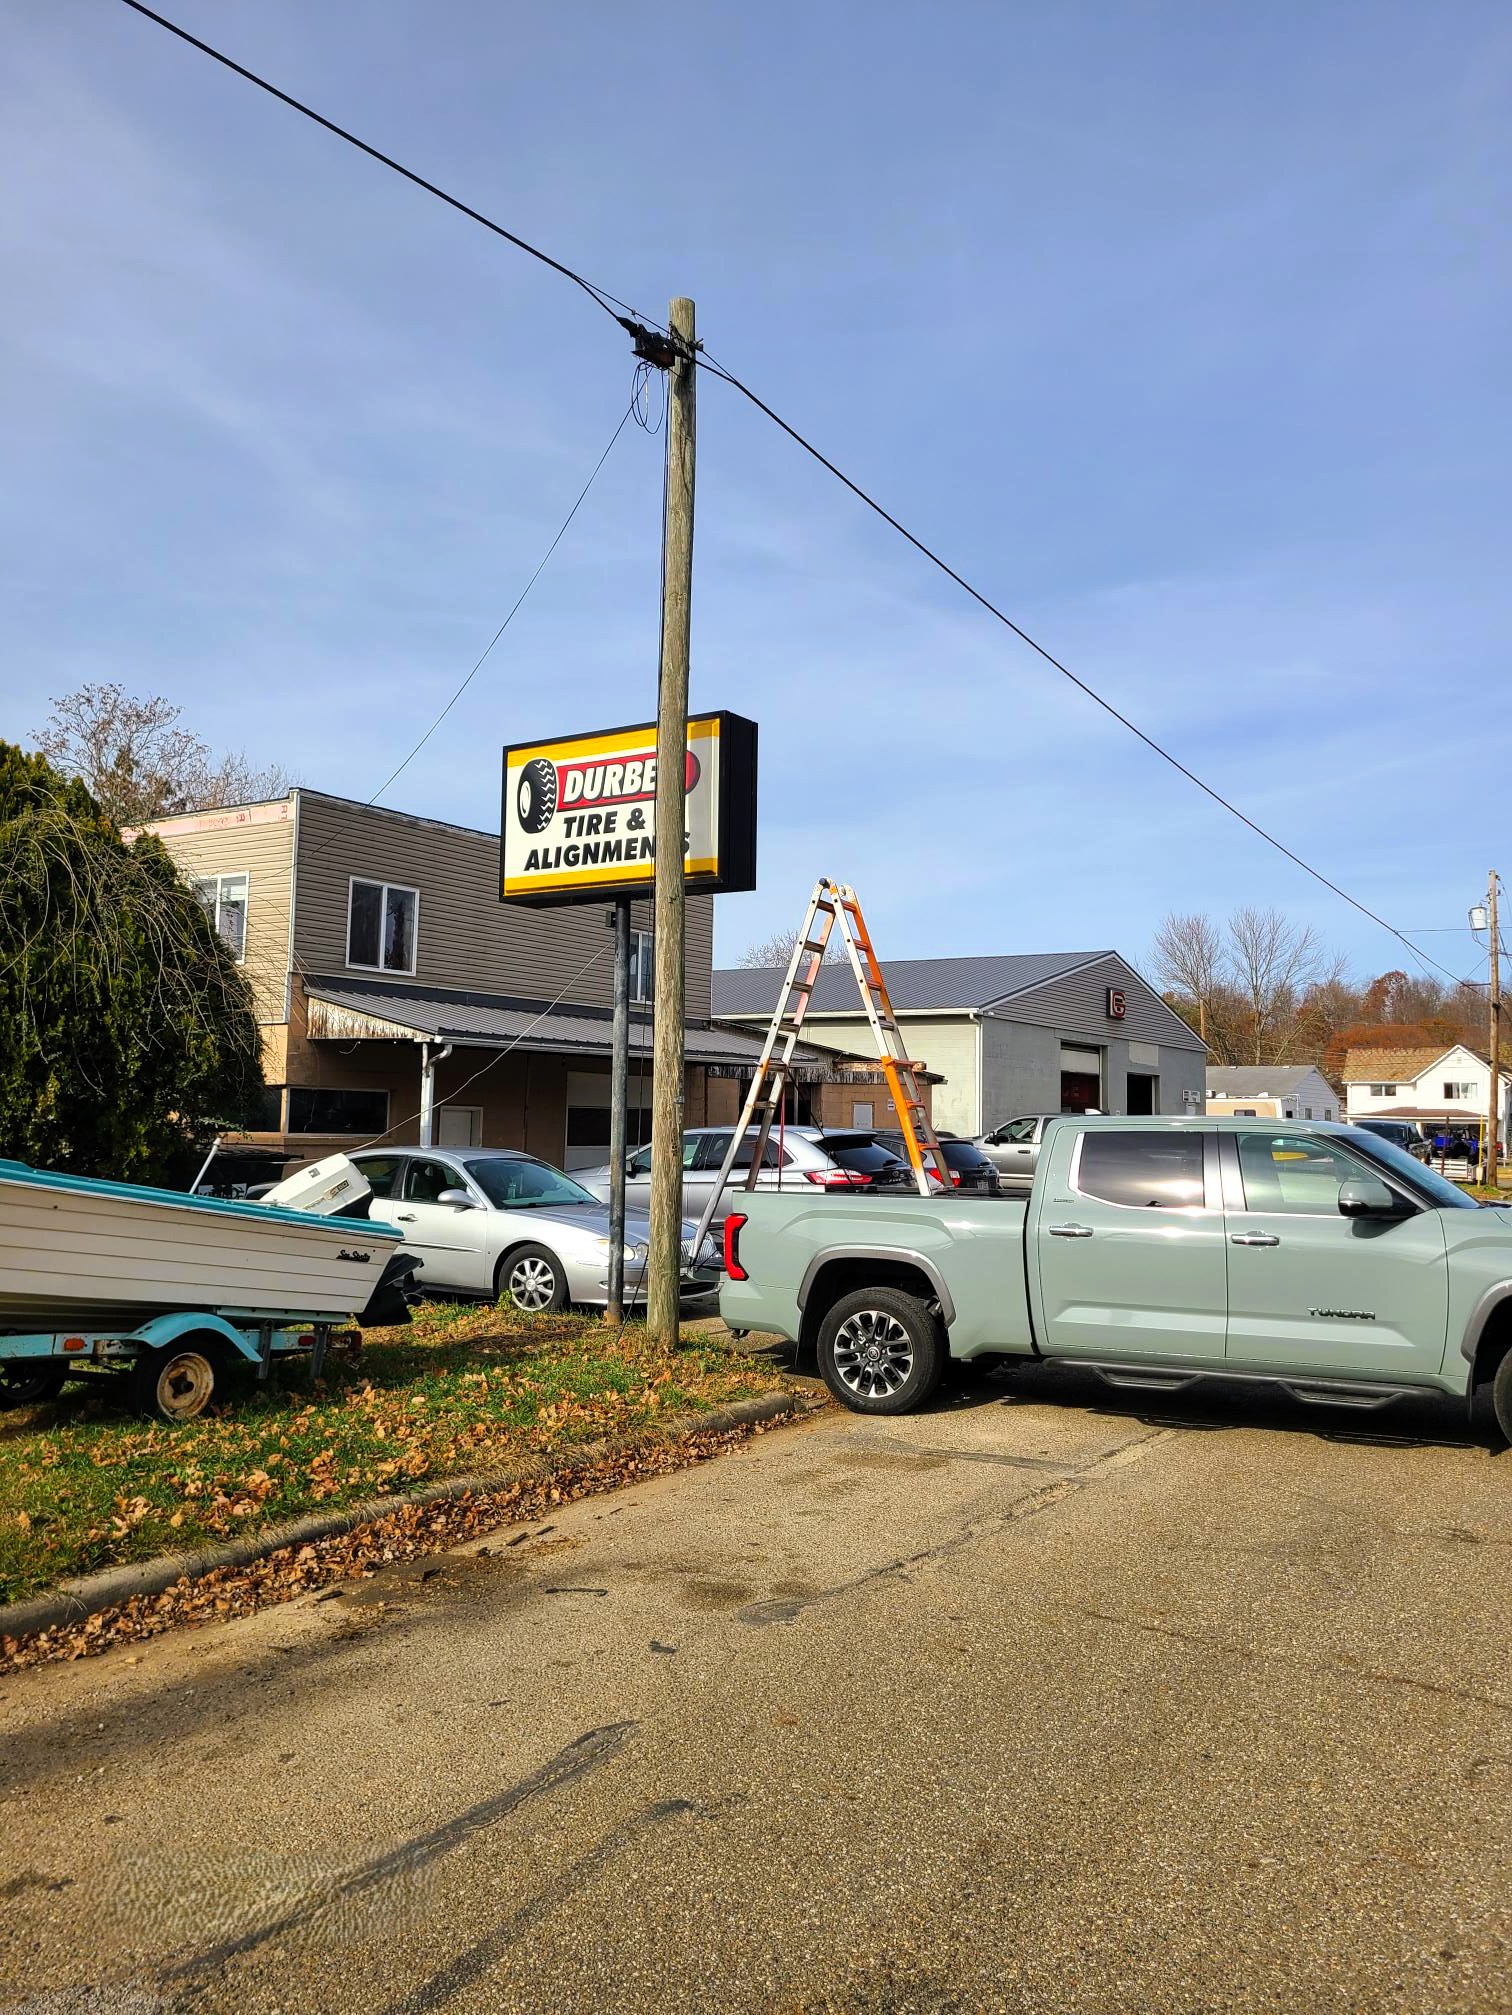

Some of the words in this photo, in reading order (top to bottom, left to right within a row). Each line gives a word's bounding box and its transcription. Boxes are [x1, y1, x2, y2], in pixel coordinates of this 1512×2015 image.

[563, 758, 661, 804] DURBE
[563, 811, 618, 838] TIRE
[626, 807, 646, 830] &
[523, 832, 690, 871] ALIGNMENS
[1306, 1307, 1375, 1320] TUNDRA
